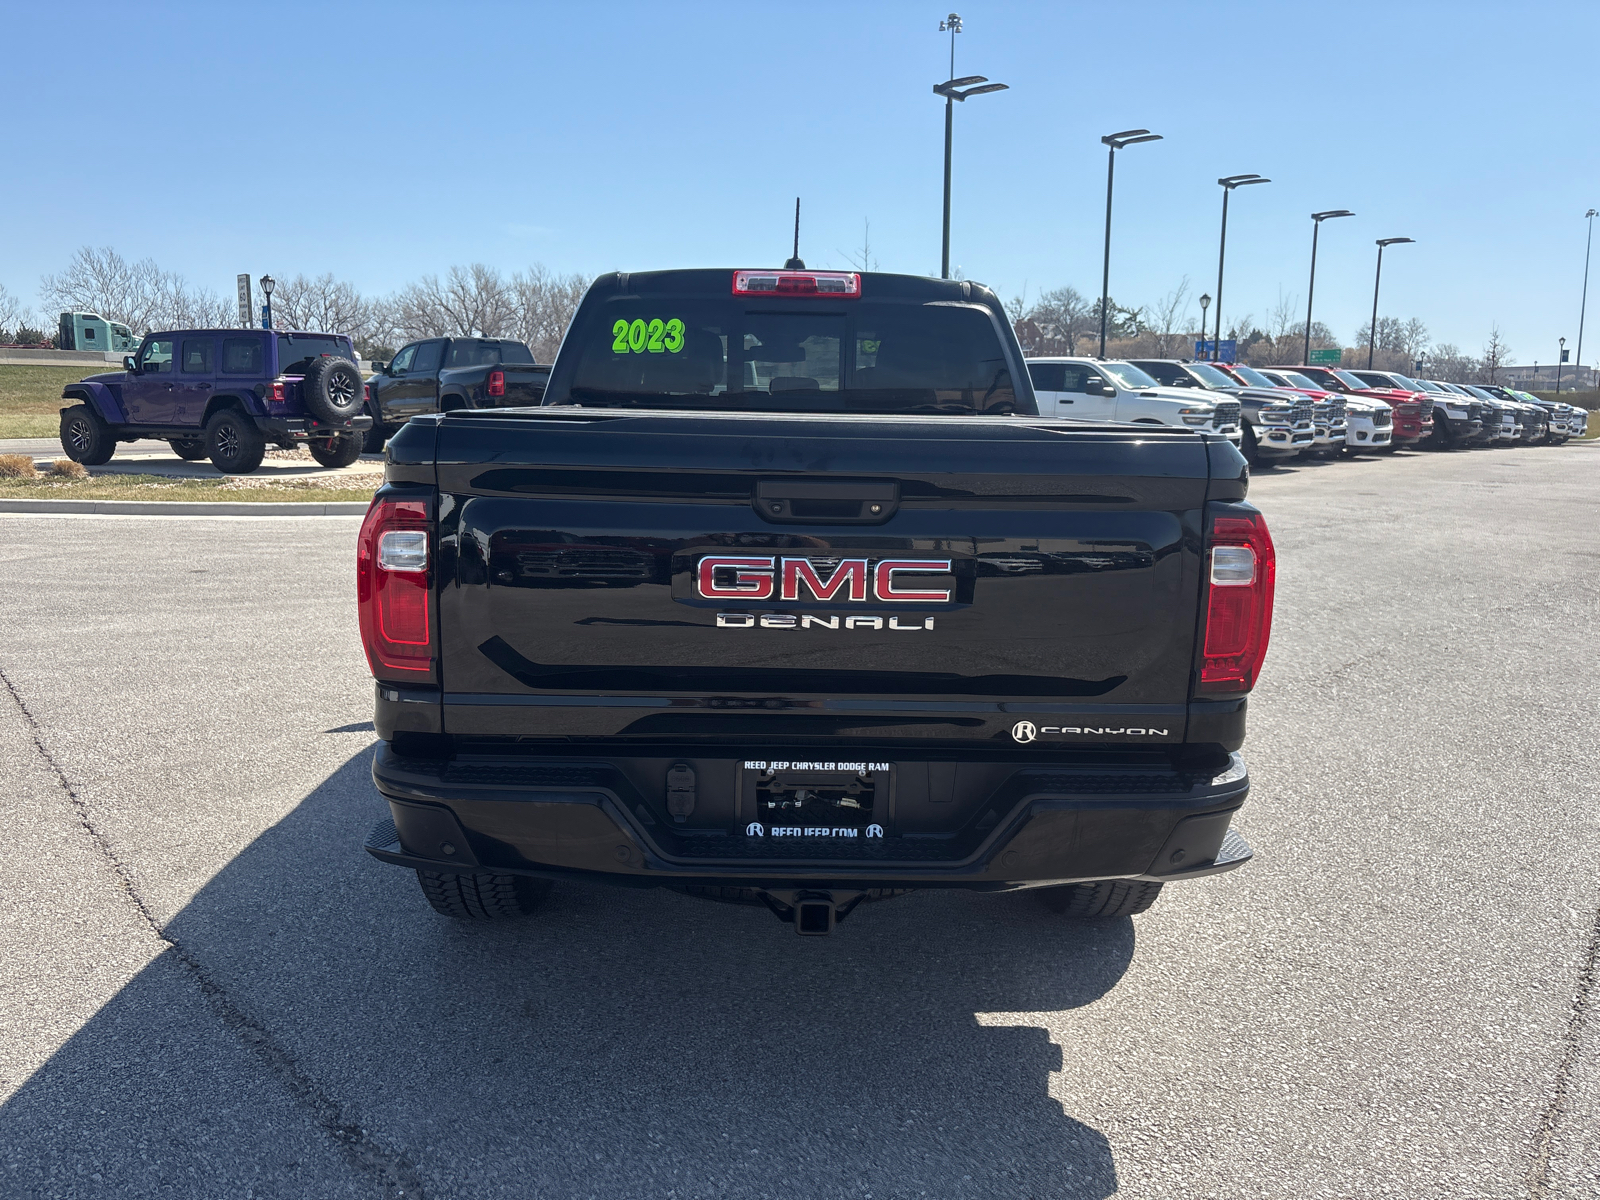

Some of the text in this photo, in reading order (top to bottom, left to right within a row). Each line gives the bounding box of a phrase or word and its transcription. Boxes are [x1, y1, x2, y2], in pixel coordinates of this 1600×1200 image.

[612, 318, 686, 354] 2023
[697, 555, 953, 602] GMC
[716, 613, 935, 631] DENALI
[1040, 726, 1169, 736] CANYON
[744, 760, 890, 772] REED JEEP CHRYSLER DODGE RAM
